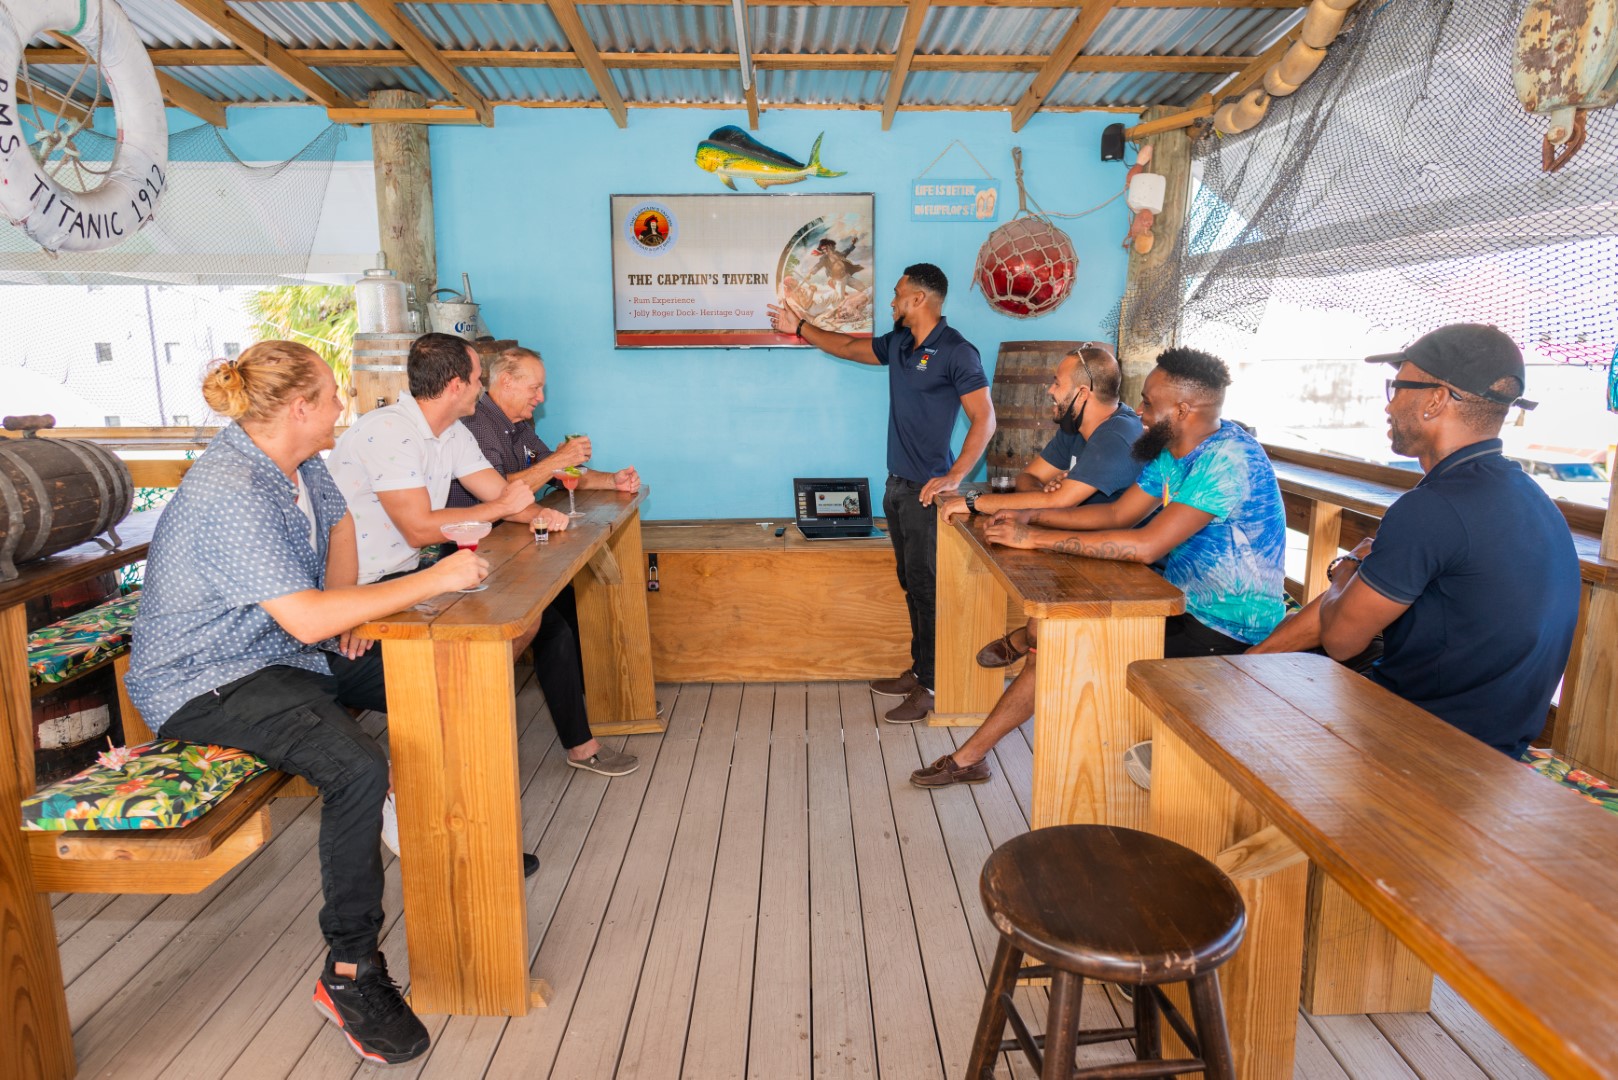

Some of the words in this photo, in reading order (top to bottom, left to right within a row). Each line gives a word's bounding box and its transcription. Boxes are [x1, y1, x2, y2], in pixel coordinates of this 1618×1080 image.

[915, 184, 934, 196] LIFE
[935, 185, 945, 196] IS
[29, 173, 124, 240] TITANIC
[130, 164, 166, 223] 1912
[628, 274, 653, 286] THE
[657, 273, 719, 286] CAPTAIN'S
[722, 273, 769, 285] TAVERN
[652, 297, 695, 305] Experience
[633, 309, 650, 318] Jolly
[652, 309, 674, 318] Roger
[700, 309, 732, 318] Heritage
[734, 309, 754, 317] Quay
